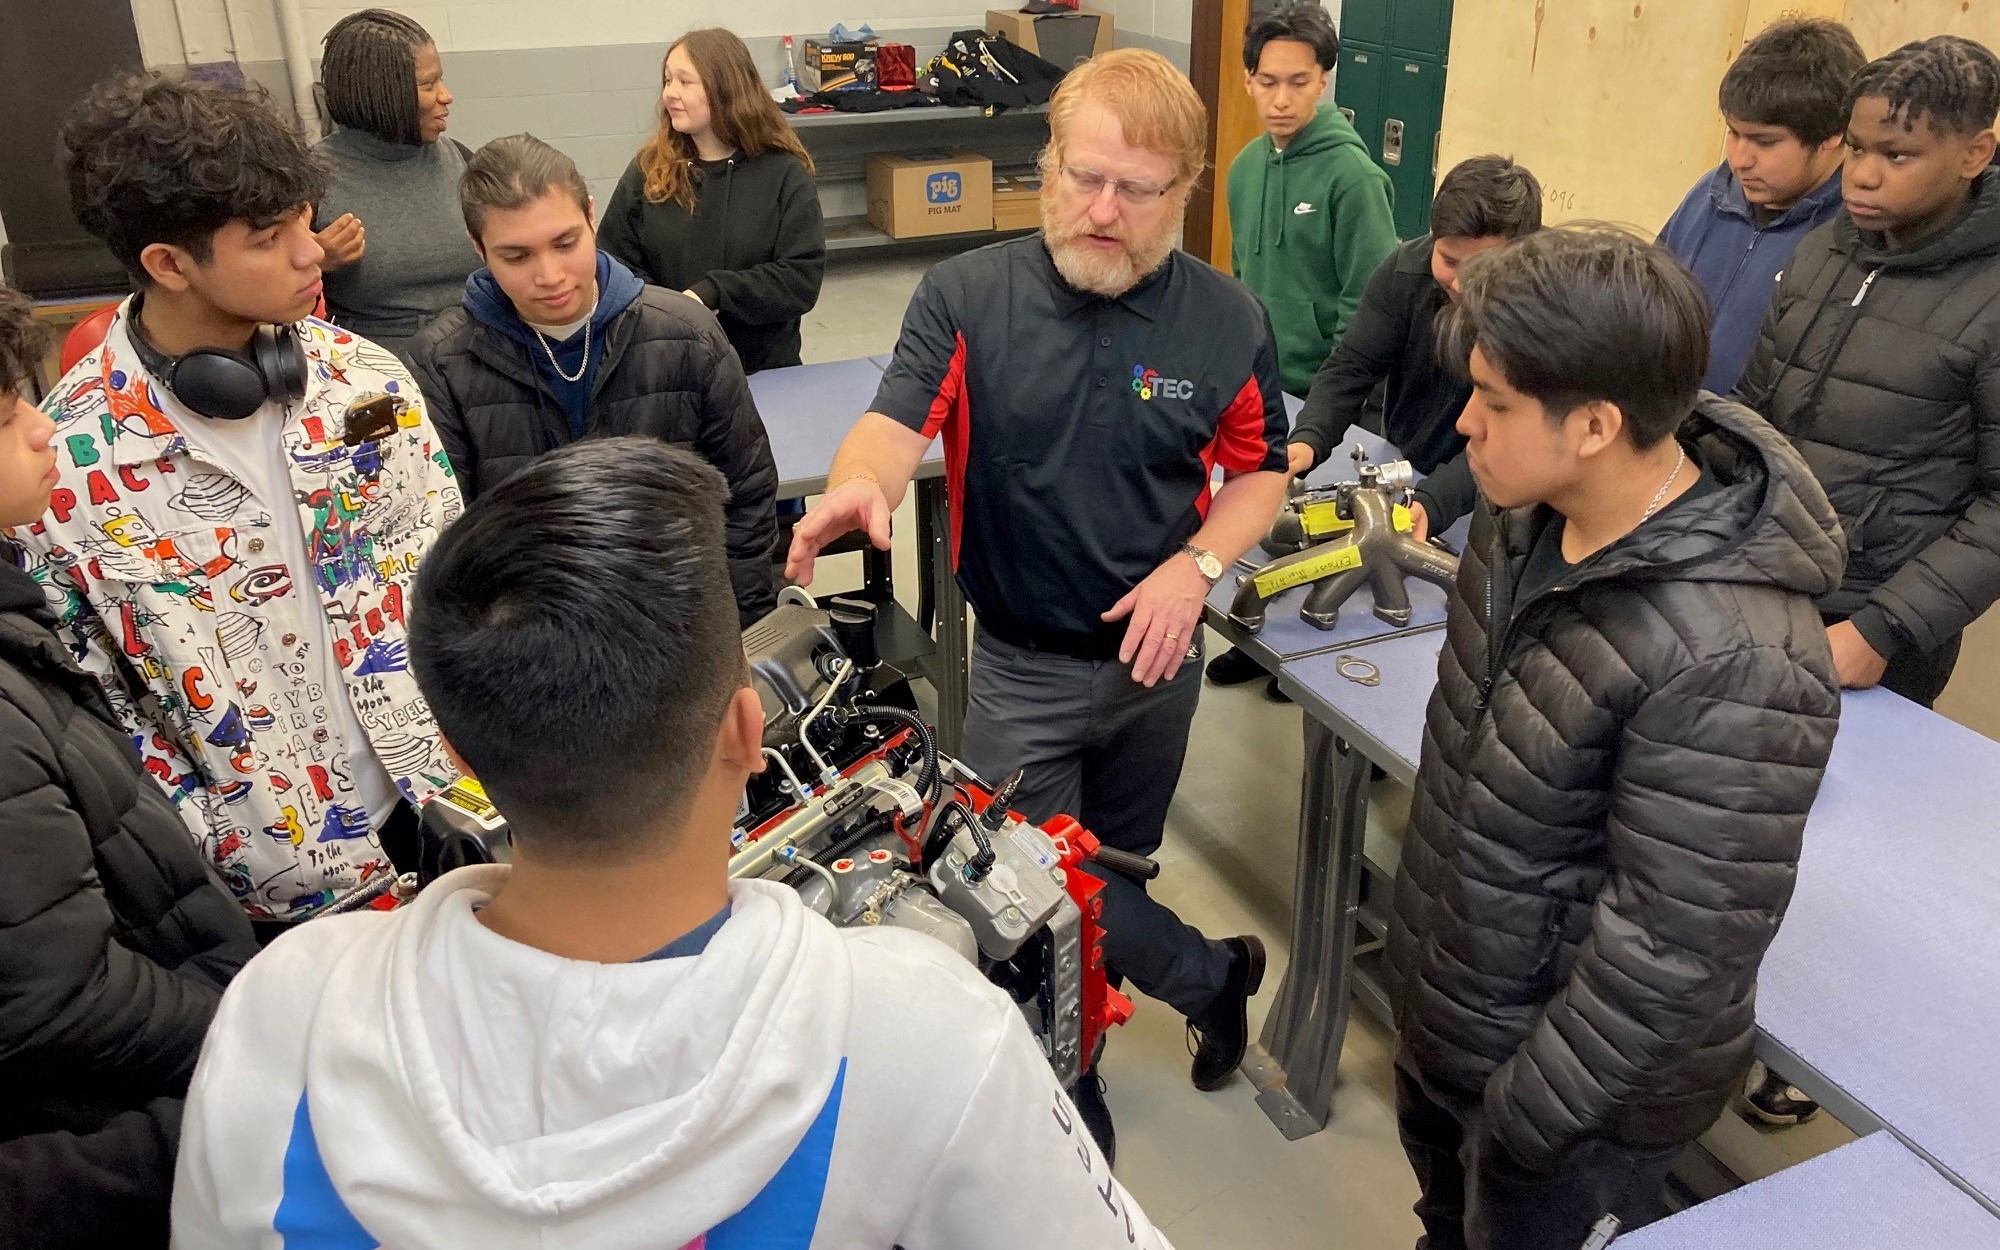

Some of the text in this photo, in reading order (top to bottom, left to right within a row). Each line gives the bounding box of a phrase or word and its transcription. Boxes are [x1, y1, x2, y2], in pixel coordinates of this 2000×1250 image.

[821, 53, 855, 62] KREW 600
[930, 175, 958, 200] pig
[928, 205, 962, 215] PIG MAT
[362, 676, 385, 693] the
[362, 696, 430, 731] CYBER
[308, 841, 343, 868] To the
